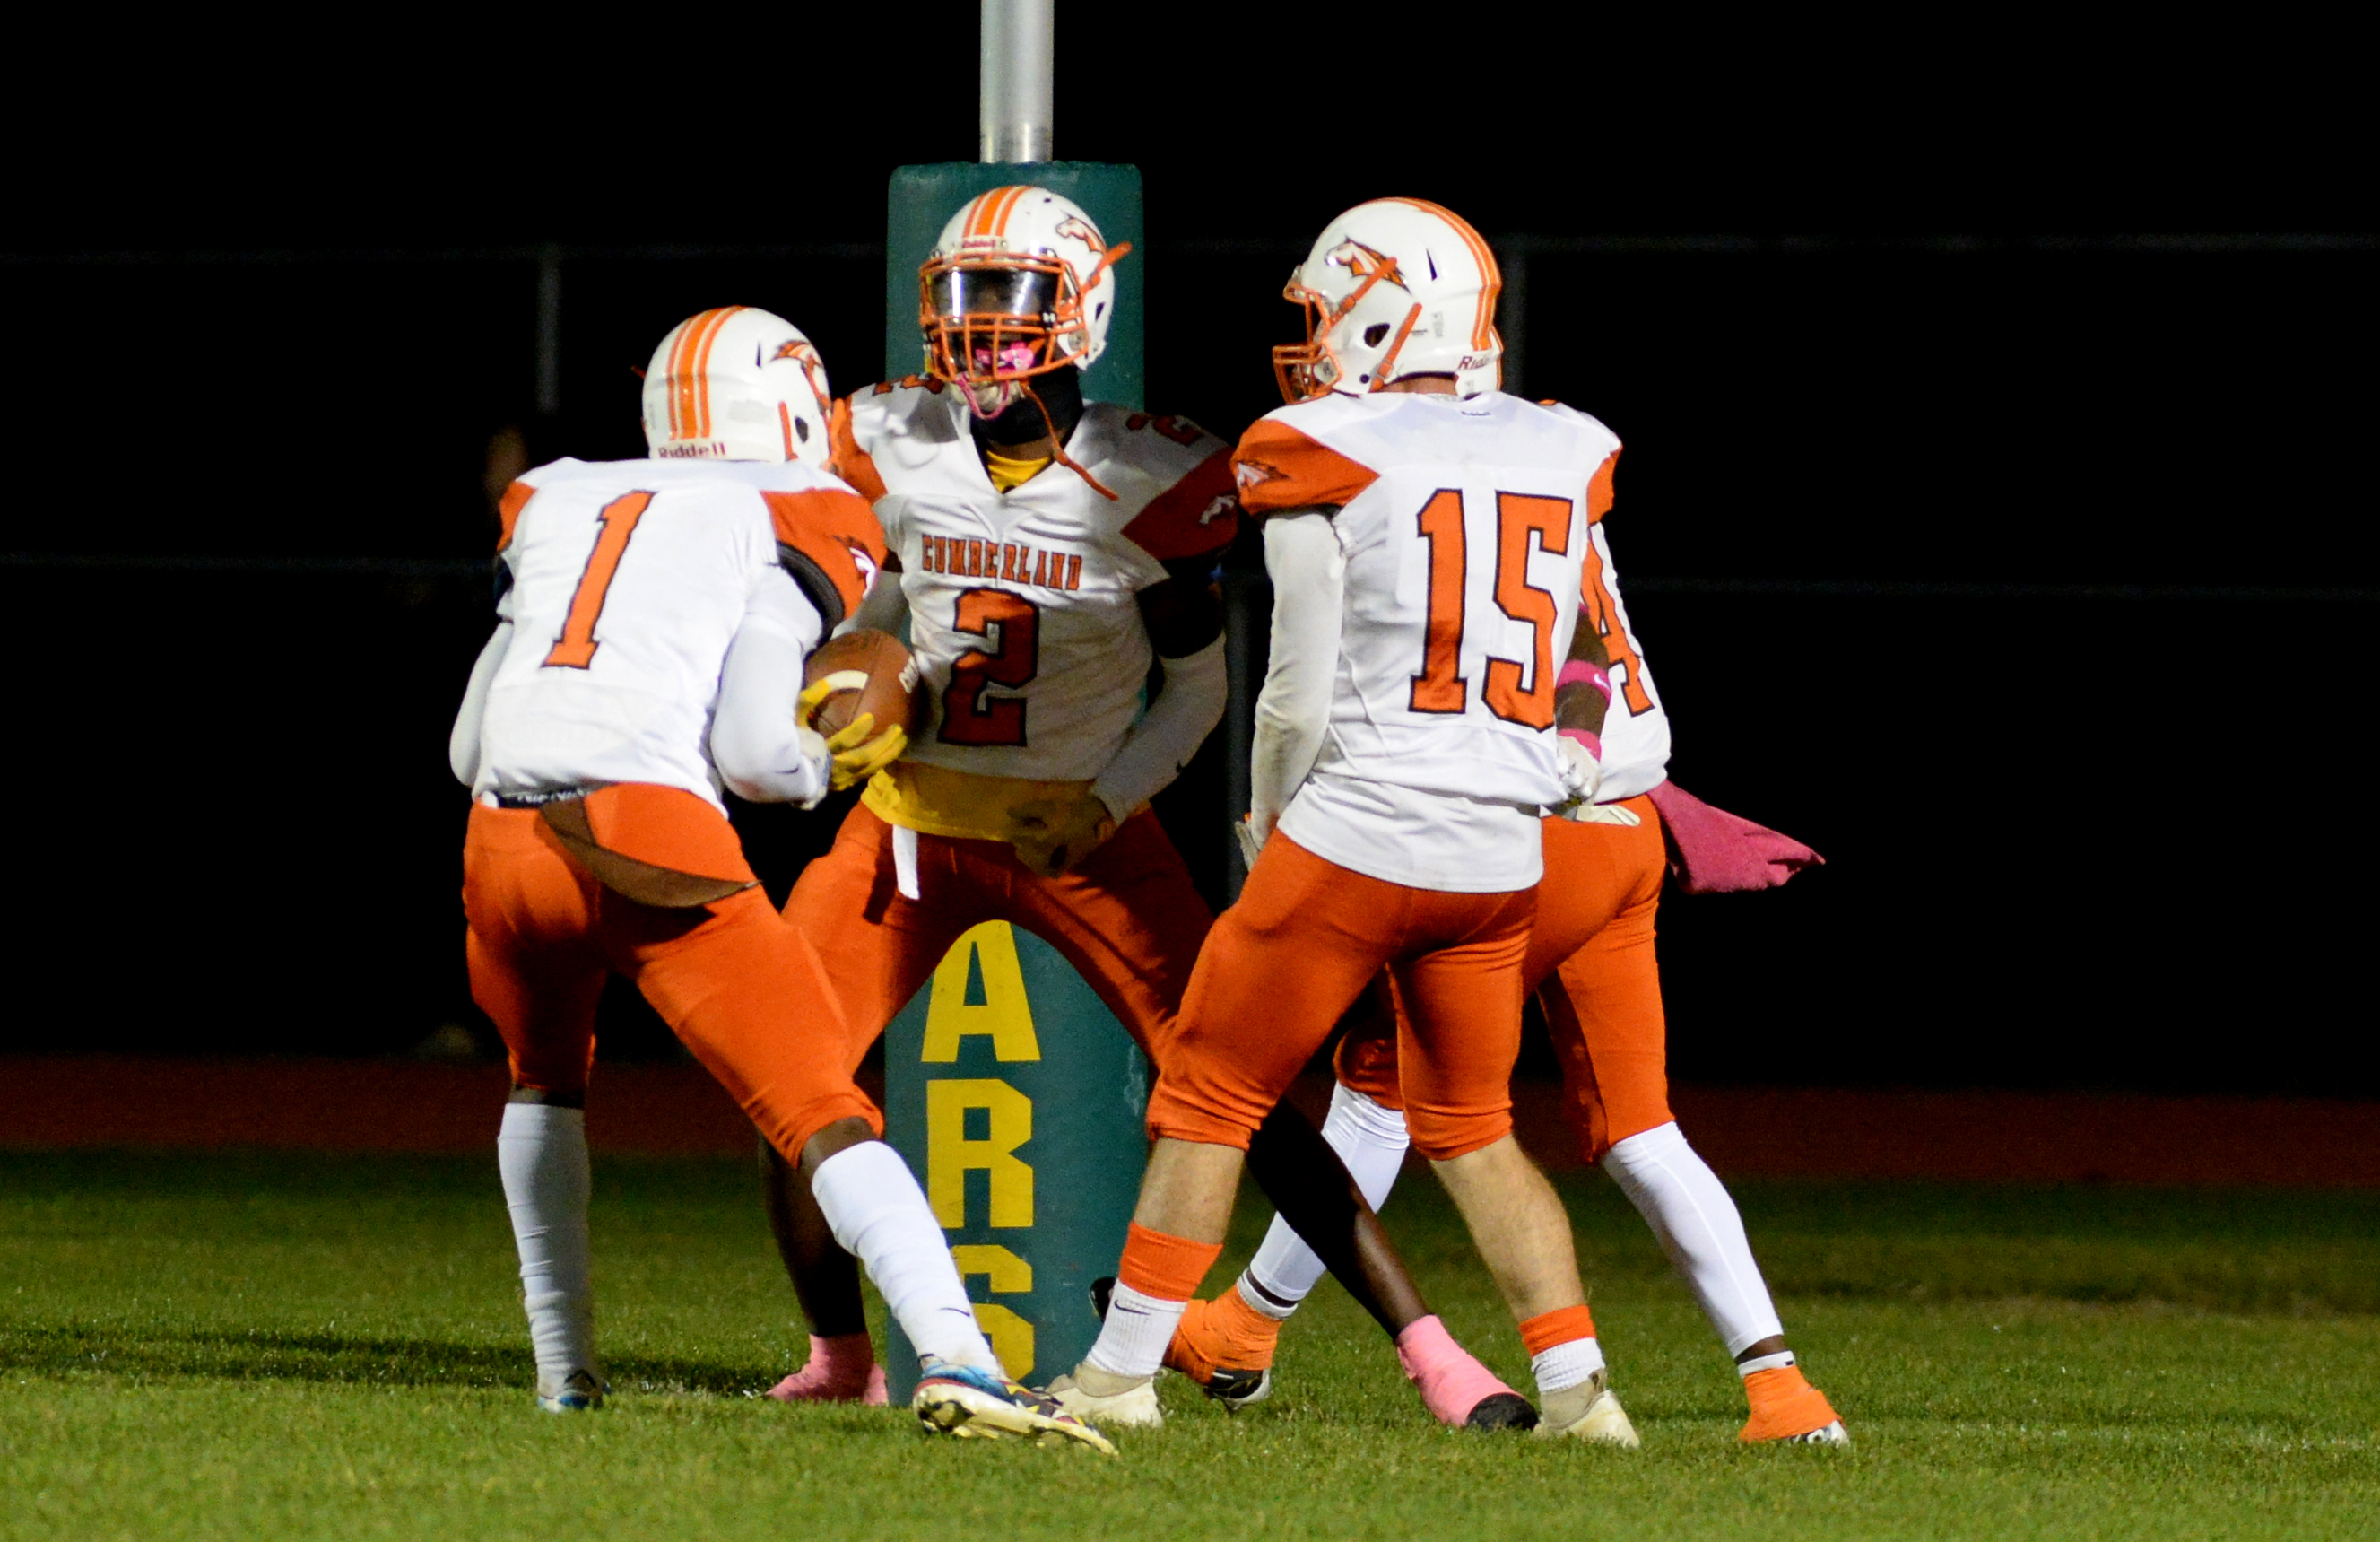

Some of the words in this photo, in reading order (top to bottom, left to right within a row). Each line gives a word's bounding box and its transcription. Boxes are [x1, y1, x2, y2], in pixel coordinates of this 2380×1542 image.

[658, 442, 725, 458] Riddell
[539, 489, 659, 669] 1
[922, 534, 1082, 591] CUMBERLAND
[1408, 489, 1574, 732] 15
[937, 587, 1039, 746] 2
